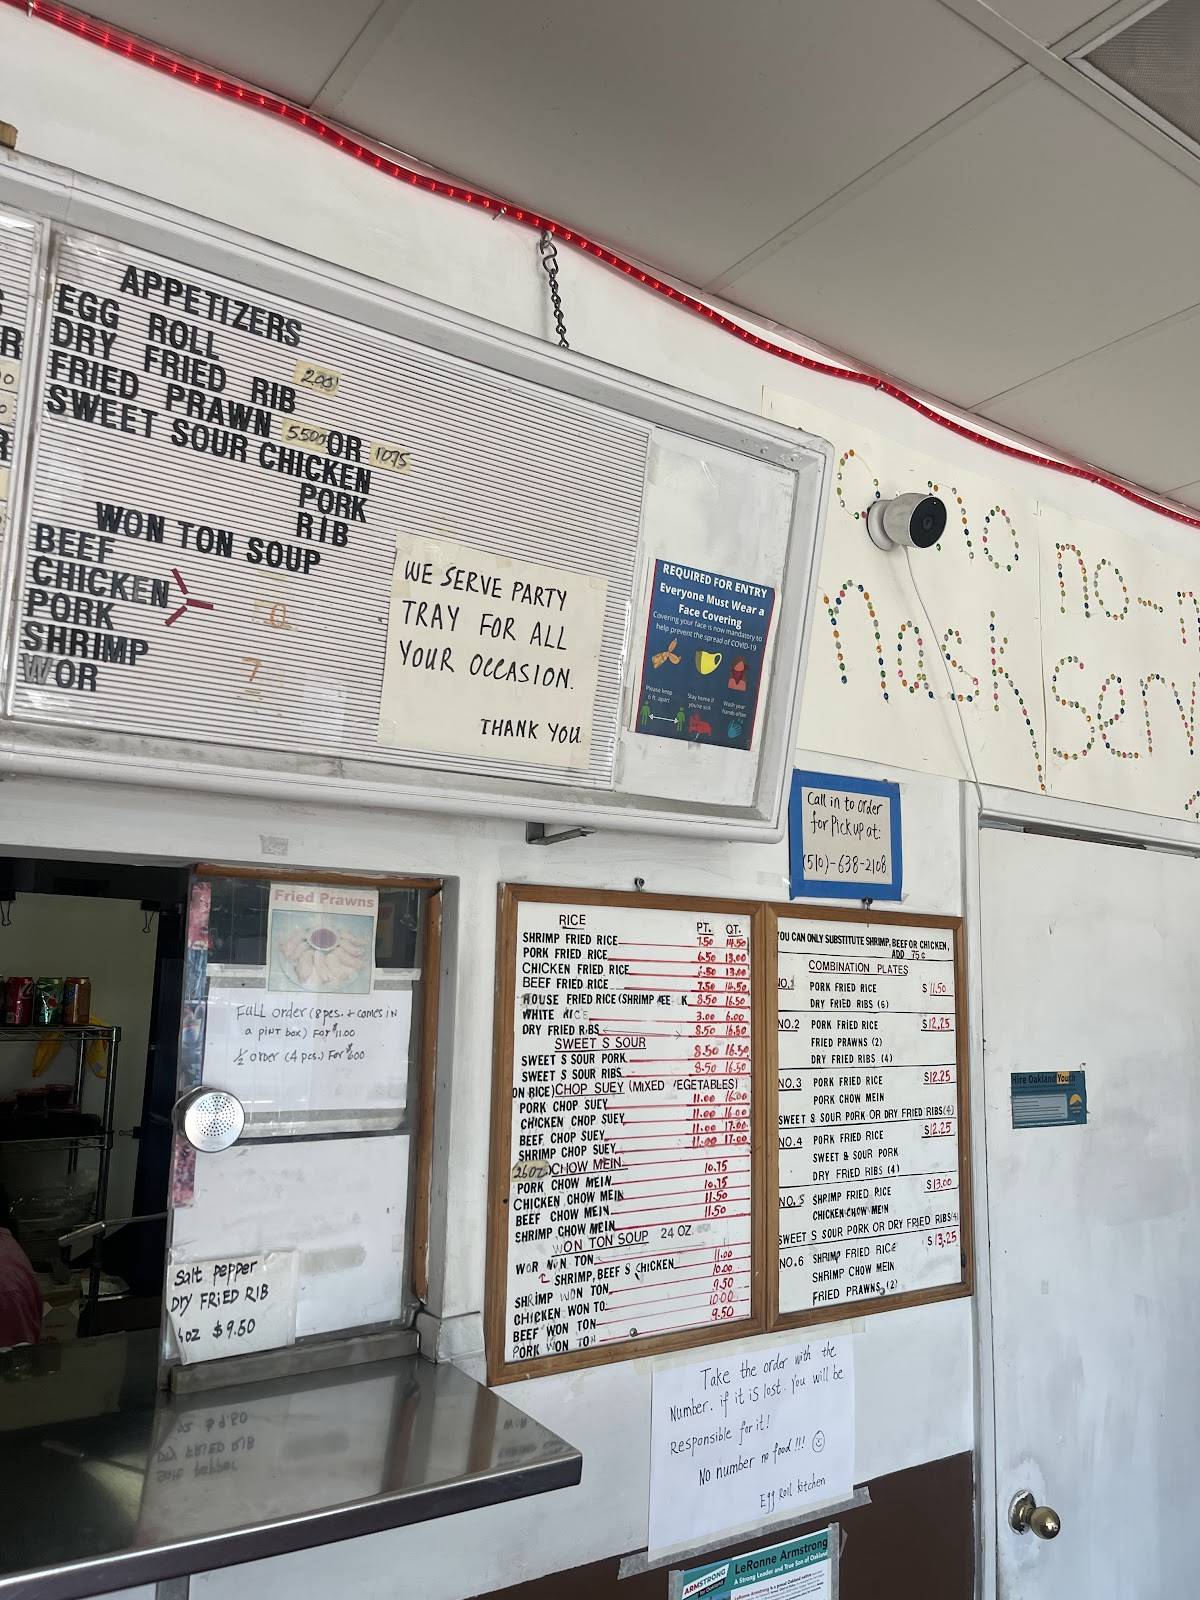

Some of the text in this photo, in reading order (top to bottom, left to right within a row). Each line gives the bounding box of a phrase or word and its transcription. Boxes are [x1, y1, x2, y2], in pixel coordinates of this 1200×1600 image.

[57, 284, 120, 329] EGG
[149, 313, 219, 360] ROLL
[120, 265, 303, 347] APPETIZERS
[52, 316, 117, 361] DRY
[144, 344, 226, 393] FRIED
[252, 377, 296, 414] RIB
[50, 352, 362, 462] FRIED PRAWN OR
[47, 384, 371, 494] SWEET SOUR CHICKEN
[299, 483, 368, 522] PORK
[34, 523, 115, 564] BEEF
[97, 503, 321, 574] WON TON SOUP
[296, 512, 349, 547] RIB
[32, 556, 169, 608] CHICKEN
[405, 560, 567, 611] WE SERVE PARTY
[663, 564, 767, 598] REQUIRED FOR ENTRY
[27, 589, 114, 630] PORK
[660, 583, 764, 616] Everyone Must Wear a
[402, 600, 567, 650] TRAY FOR ALL
[653, 611, 679, 624] Covering
[695, 620, 706, 628] face
[726, 629, 755, 641] mandatory
[679, 604, 742, 630] Face Covering
[23, 621, 149, 665] SHRIMP
[656, 623, 669, 633] help
[670, 627, 692, 637] prevent
[694, 631, 703, 639] the
[704, 634, 723, 644] spread
[731, 640, 756, 651] COVID-19
[22, 653, 99, 691] WOR
[400, 640, 574, 689] YOUR OCCASION.
[481, 719, 539, 739] THANK
[808, 792, 826, 807] Call
[831, 796, 840, 808] in
[845, 797, 854, 811] to
[811, 811, 828, 834] for
[274, 889, 374, 908] Fried Prawns
[559, 915, 586, 925] RICE
[523, 932, 618, 945] SHRIMP FRIED RICE
[524, 947, 549, 958] PORK
[555, 949, 581, 959] FRIED
[588, 950, 608, 959] RICE
[808, 960, 909, 975] COMBINATION PLATES
[810, 982, 831, 992] PORK
[835, 982, 856, 992] FRIED
[860, 984, 877, 993] RICE
[810, 999, 889, 1009] DRY FRIED RIBS (6)
[272, 1002, 307, 1018] order
[813, 1152, 839, 1163] SWEET
[853, 1149, 872, 1160] SOUR
[879, 1148, 899, 1158] PORK
[517, 1182, 544, 1194] PORK
[551, 1178, 579, 1190] CHOW
[586, 1176, 611, 1188] MEIN
[174, 1261, 258, 1286] Salt pepper
[245, 1284, 269, 1302] RIB
[812, 1288, 840, 1306] FRIED
[886, 1280, 898, 1290] (2)
[700, 1341, 837, 1390] Take the order with the
[670, 1398, 713, 1421] Number.
[721, 1391, 729, 1418] if
[735, 1388, 745, 1404] it
[813, 1366, 828, 1384] will
[834, 1365, 843, 1380] be
[739, 1420, 753, 1445] for
[716, 1455, 755, 1479] number
[762, 1453, 769, 1463] no
[761, 1490, 775, 1514] Egg
[798, 1473, 826, 1494] kitchen
[735, 1538, 828, 1575] LeRonne Armstrong
[739, 1574, 756, 1584] Strong
[757, 1570, 773, 1579] Leader
[774, 1566, 783, 1574] and
[784, 1562, 794, 1571] True
[810, 1551, 828, 1560] Oakland
[684, 1567, 726, 1595] ARMSTRONG
